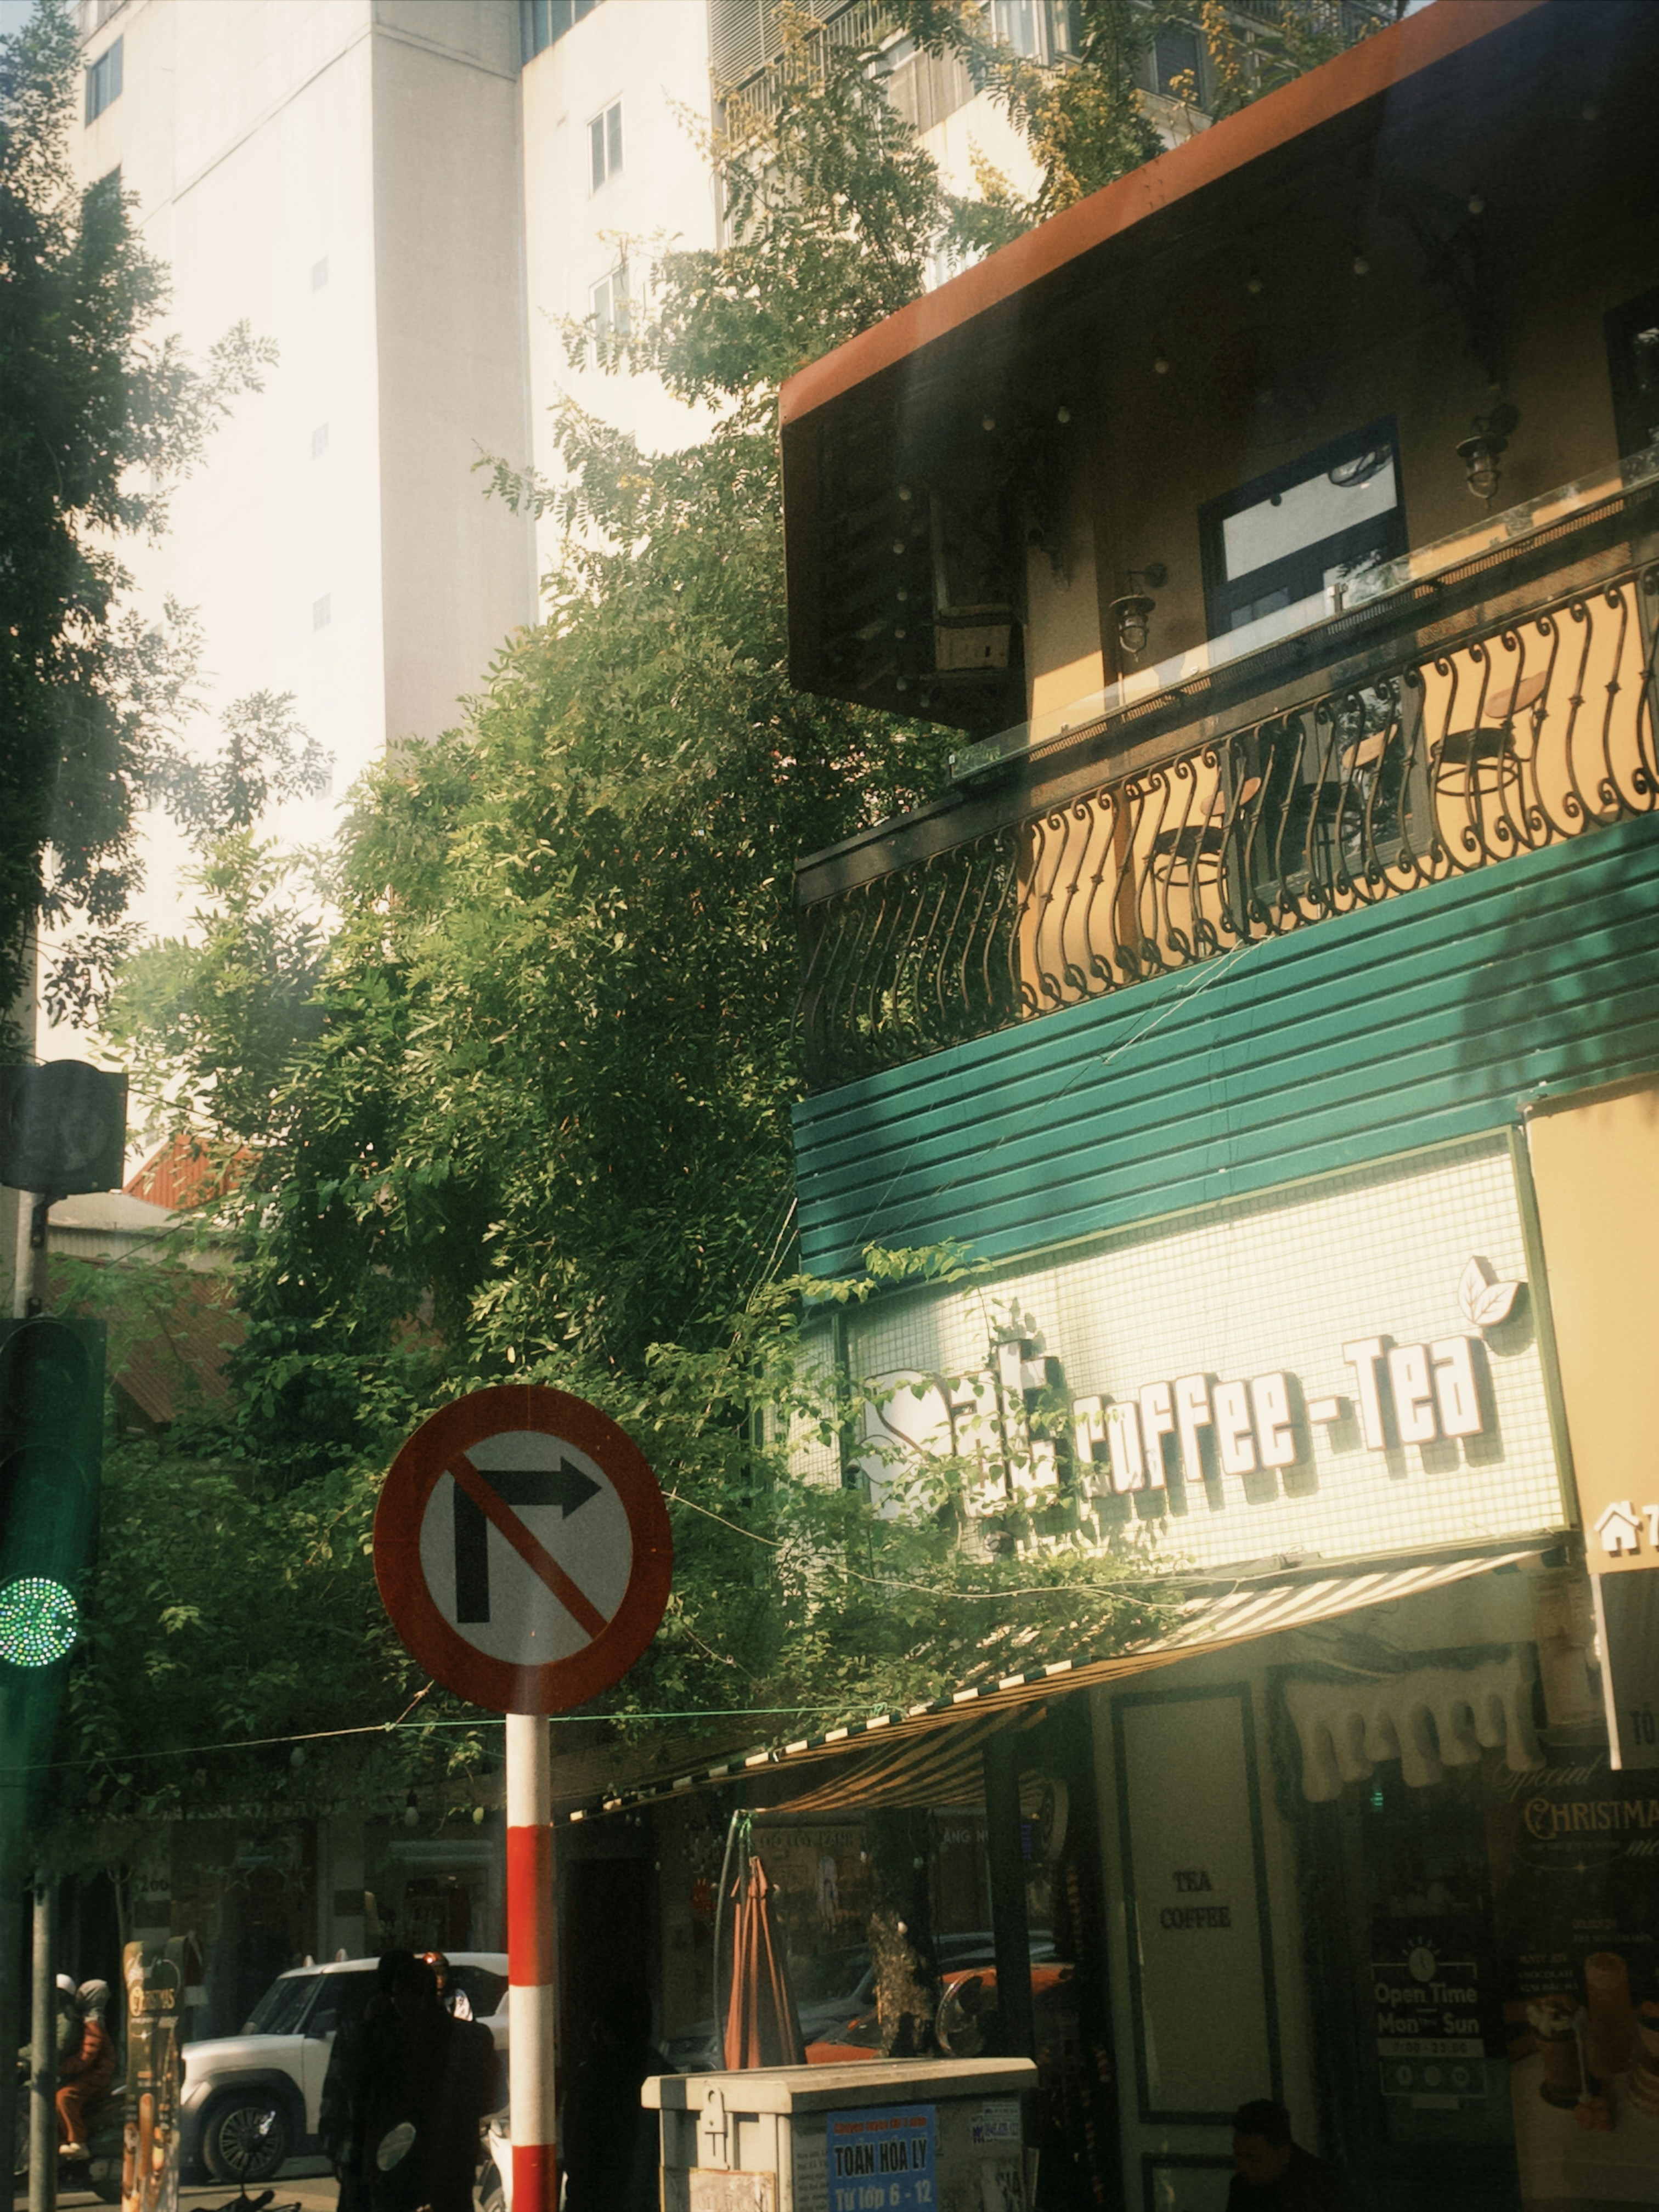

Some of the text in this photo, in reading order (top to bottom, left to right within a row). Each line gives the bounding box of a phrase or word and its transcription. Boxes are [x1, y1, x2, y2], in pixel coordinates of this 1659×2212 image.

[1342, 1334, 1485, 1451] Tea
[1172, 1870, 1212, 1892] TEA
[1160, 1905, 1231, 1929] COFFEE
[1374, 1982, 1477, 2007] Open Time
[1377, 2012, 1419, 2033] Mon
[1443, 2012, 1480, 2033] Sun
[834, 2137, 876, 2179] TOÁN
[879, 2135, 909, 2175] HÓA
[911, 2134, 928, 2170] LÝ
[859, 2184, 885, 2209] lớp
[889, 2183, 900, 2206] 6
[914, 2180, 932, 2204] 12
